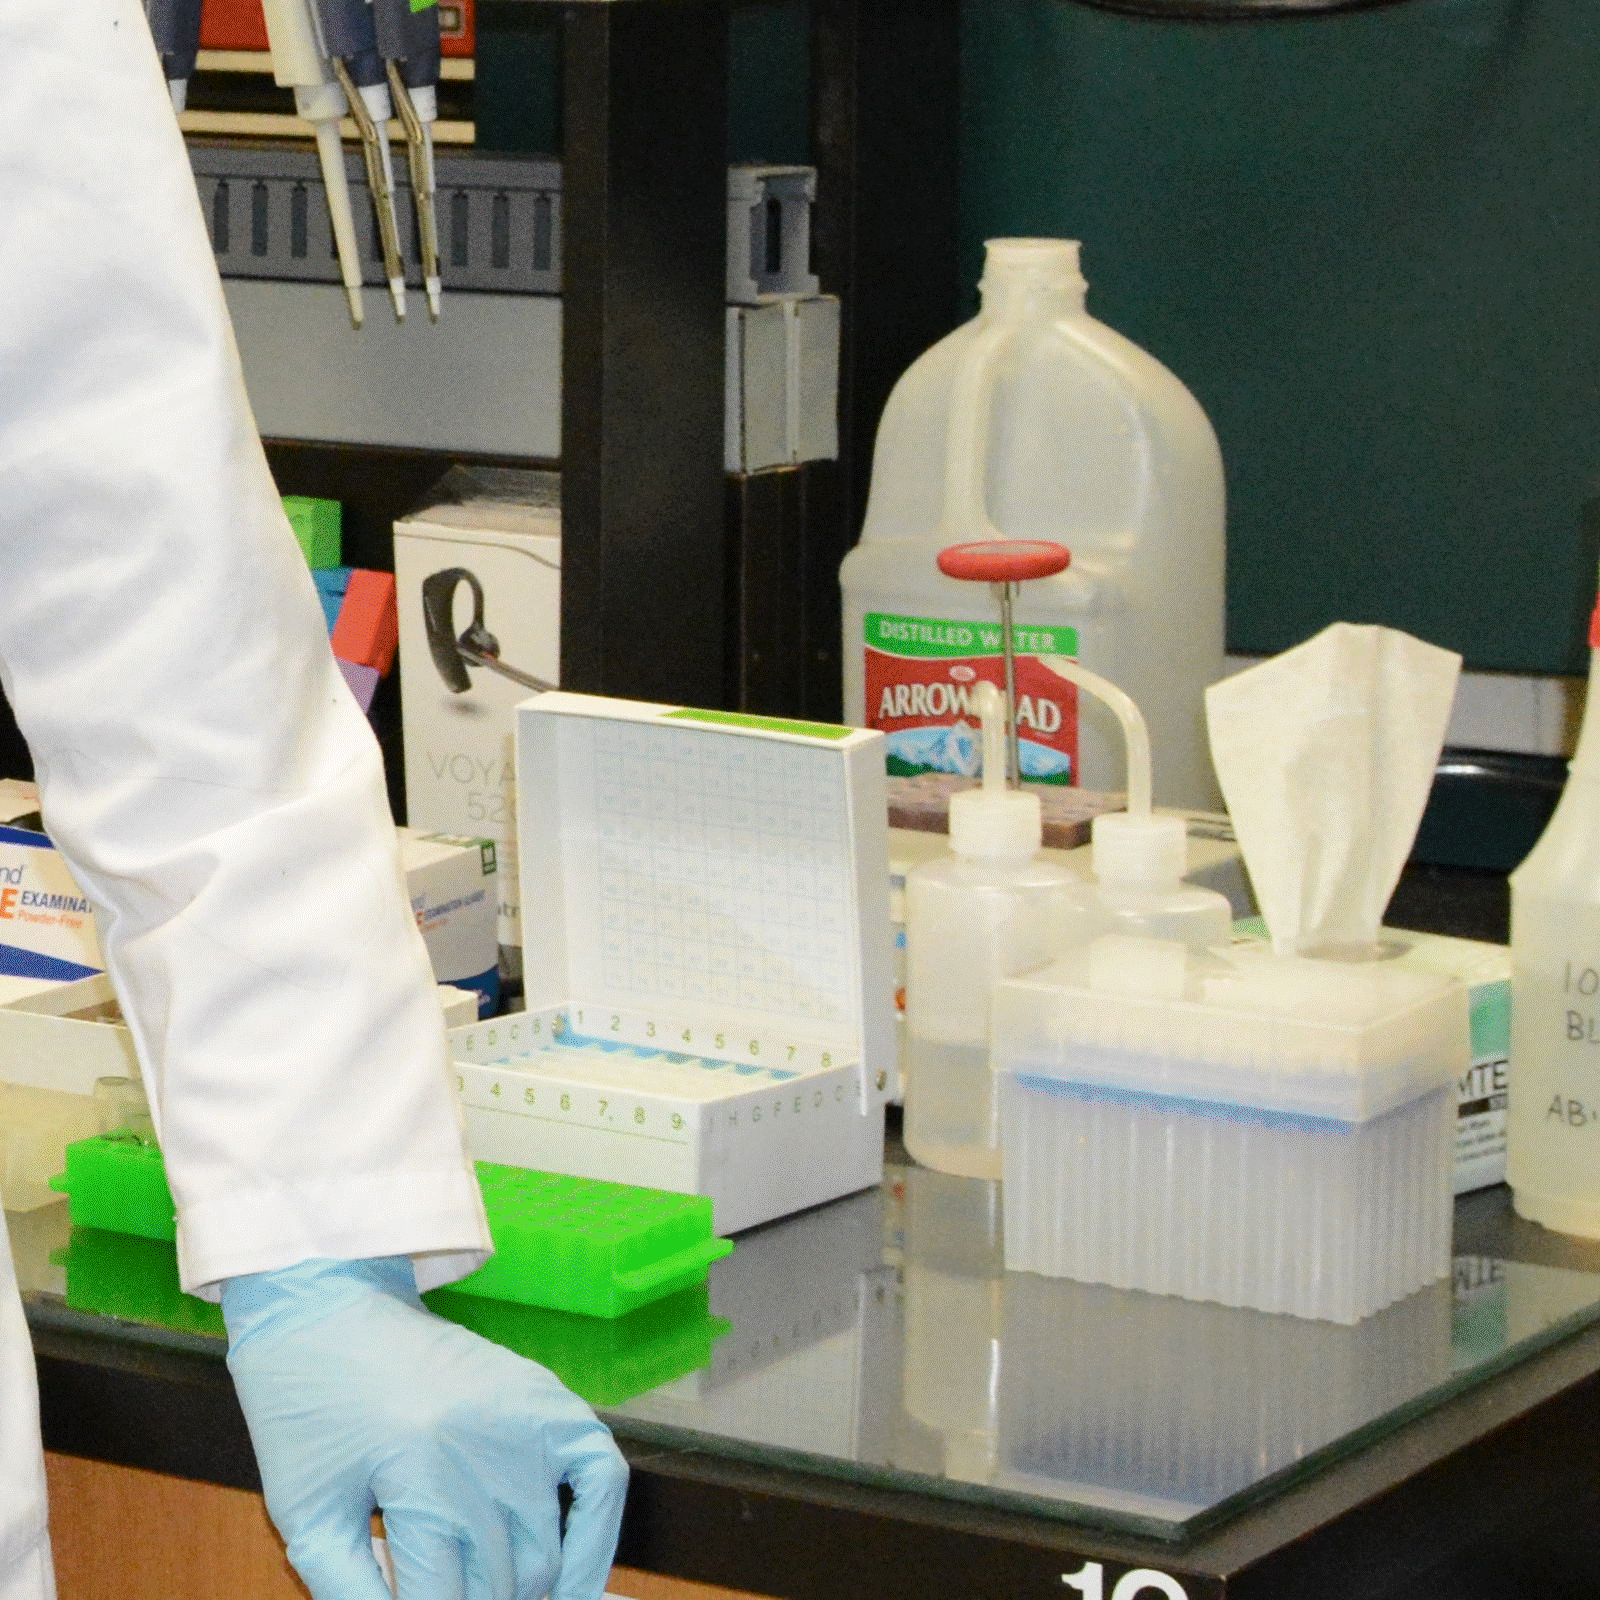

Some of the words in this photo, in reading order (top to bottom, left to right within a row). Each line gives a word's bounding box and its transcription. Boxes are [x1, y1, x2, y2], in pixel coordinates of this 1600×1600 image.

[880, 620, 973, 647] DISTILLED
[979, 629, 1056, 651] WTER
[879, 683, 1063, 734] ARROWAD
[423, 752, 516, 786] VOYA
[21, 889, 93, 916] EXAMINA
